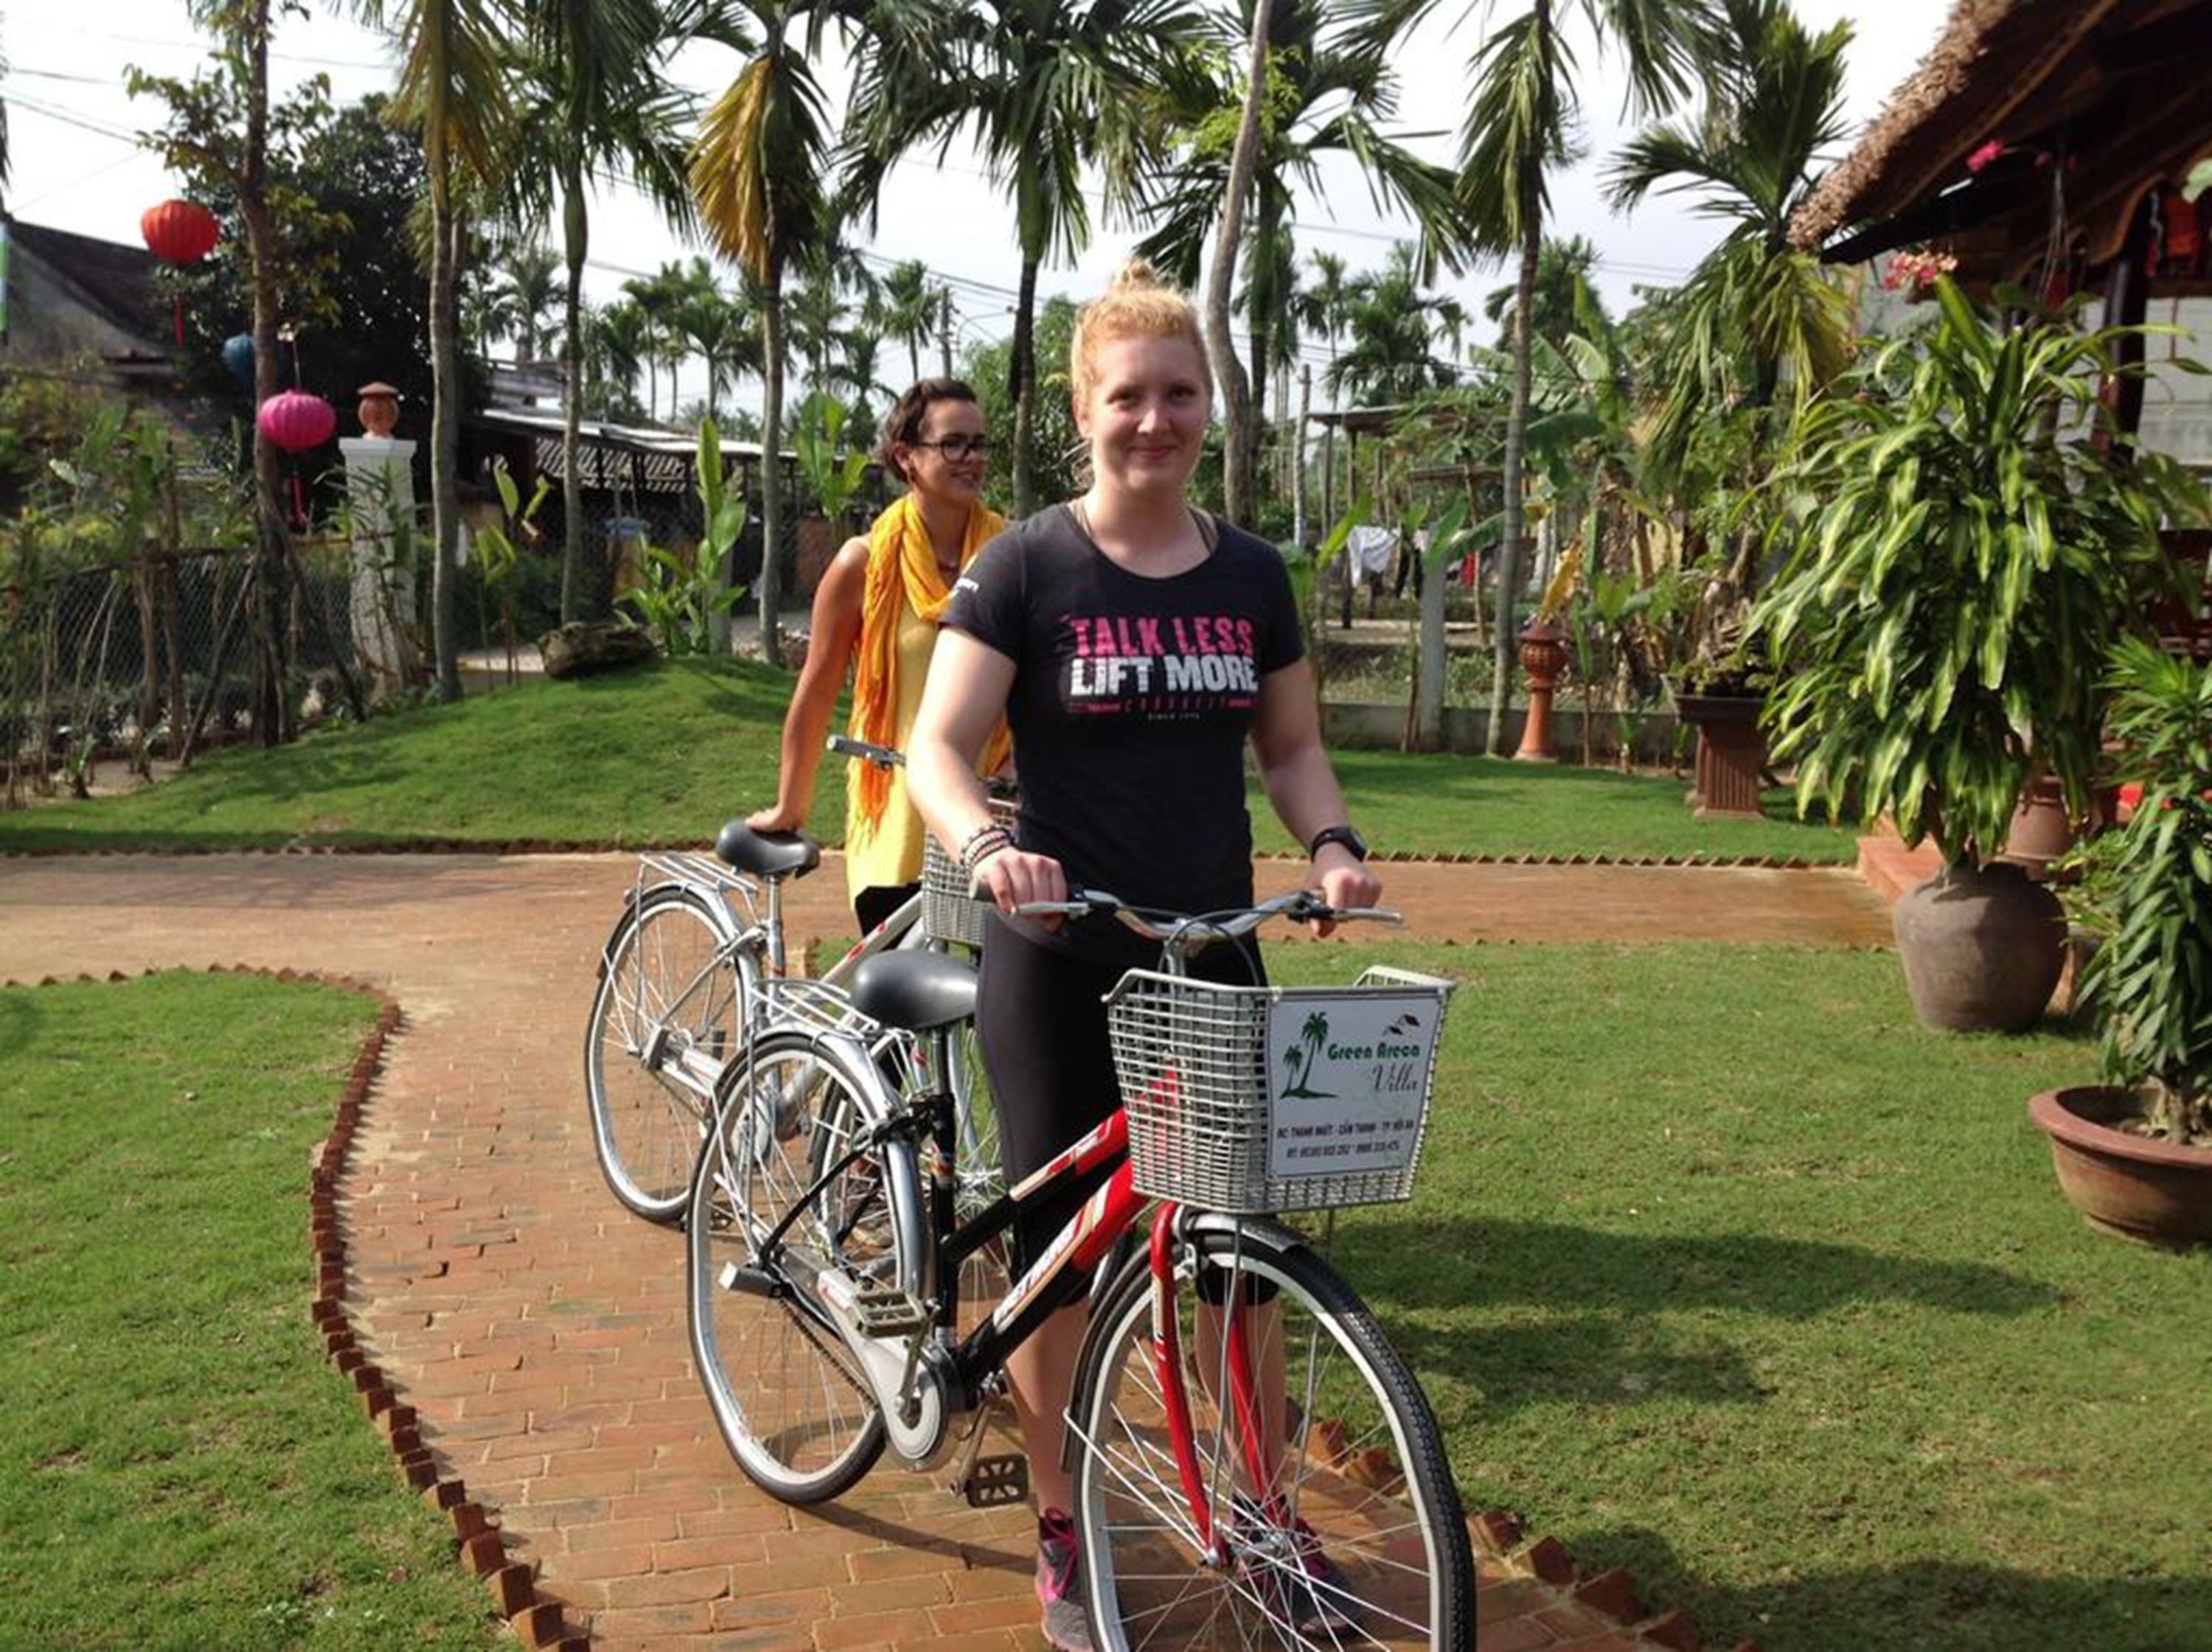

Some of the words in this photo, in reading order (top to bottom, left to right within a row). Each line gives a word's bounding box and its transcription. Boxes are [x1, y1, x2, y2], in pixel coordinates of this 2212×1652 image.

[1071, 617, 1165, 656] TALK
[1173, 617, 1253, 656] LESS
[1071, 656, 1154, 695] LIFT
[1164, 654, 1259, 693] MORE
[1328, 1043, 1372, 1060] Green
[1372, 1062, 1418, 1092] Villa
